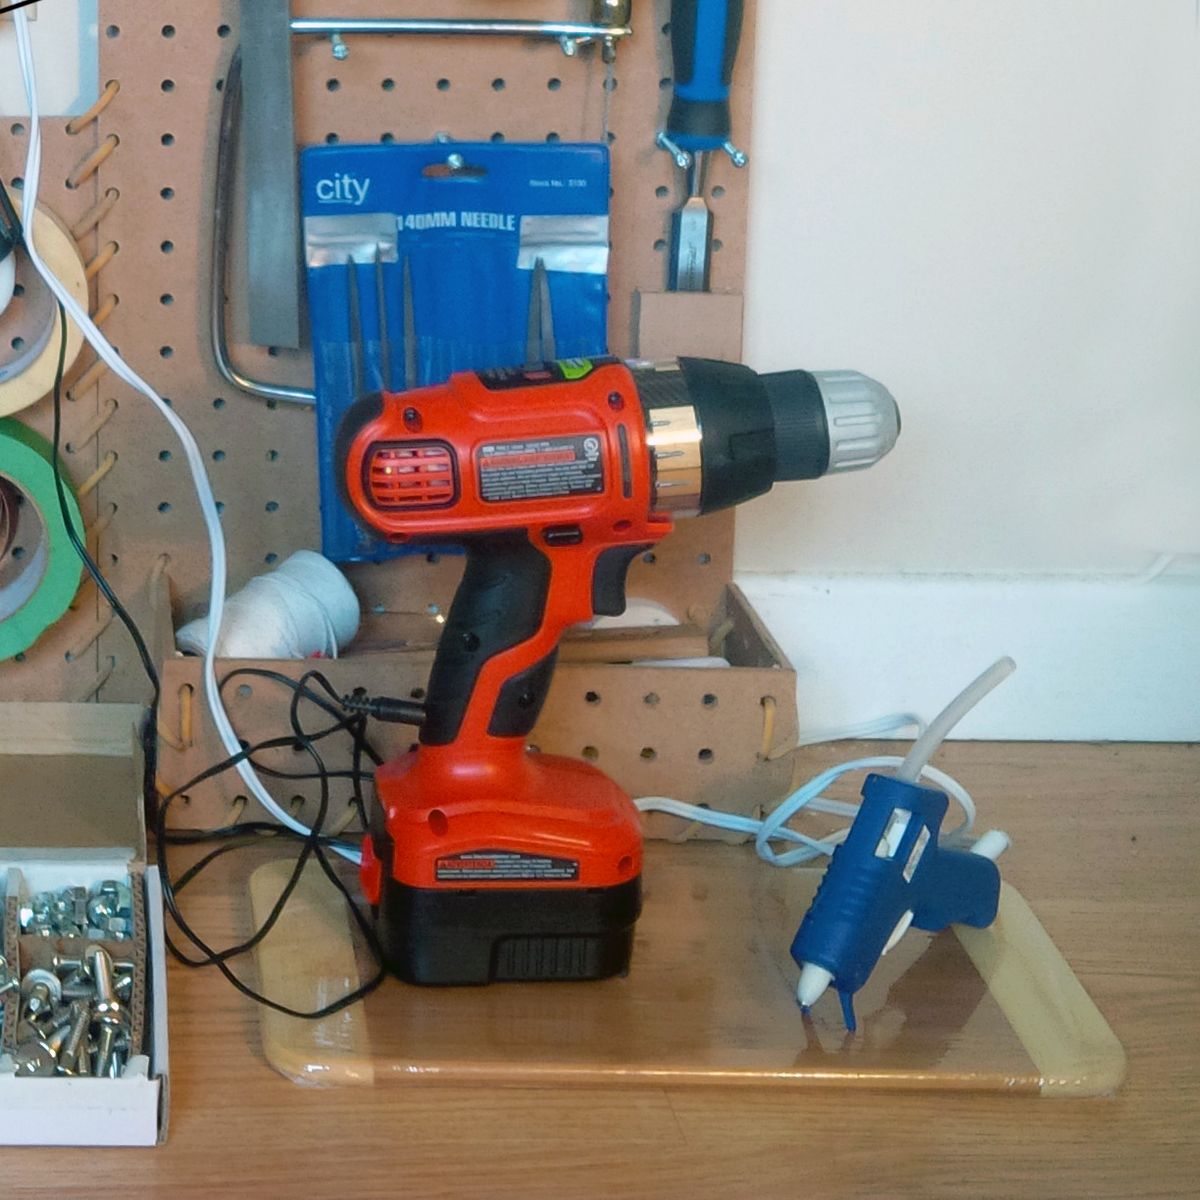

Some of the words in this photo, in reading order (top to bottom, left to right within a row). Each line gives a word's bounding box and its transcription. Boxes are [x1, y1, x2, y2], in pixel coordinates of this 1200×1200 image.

[316, 172, 370, 206] city
[396, 211, 457, 232] 140MM
[460, 211, 516, 232] NEEDLE
